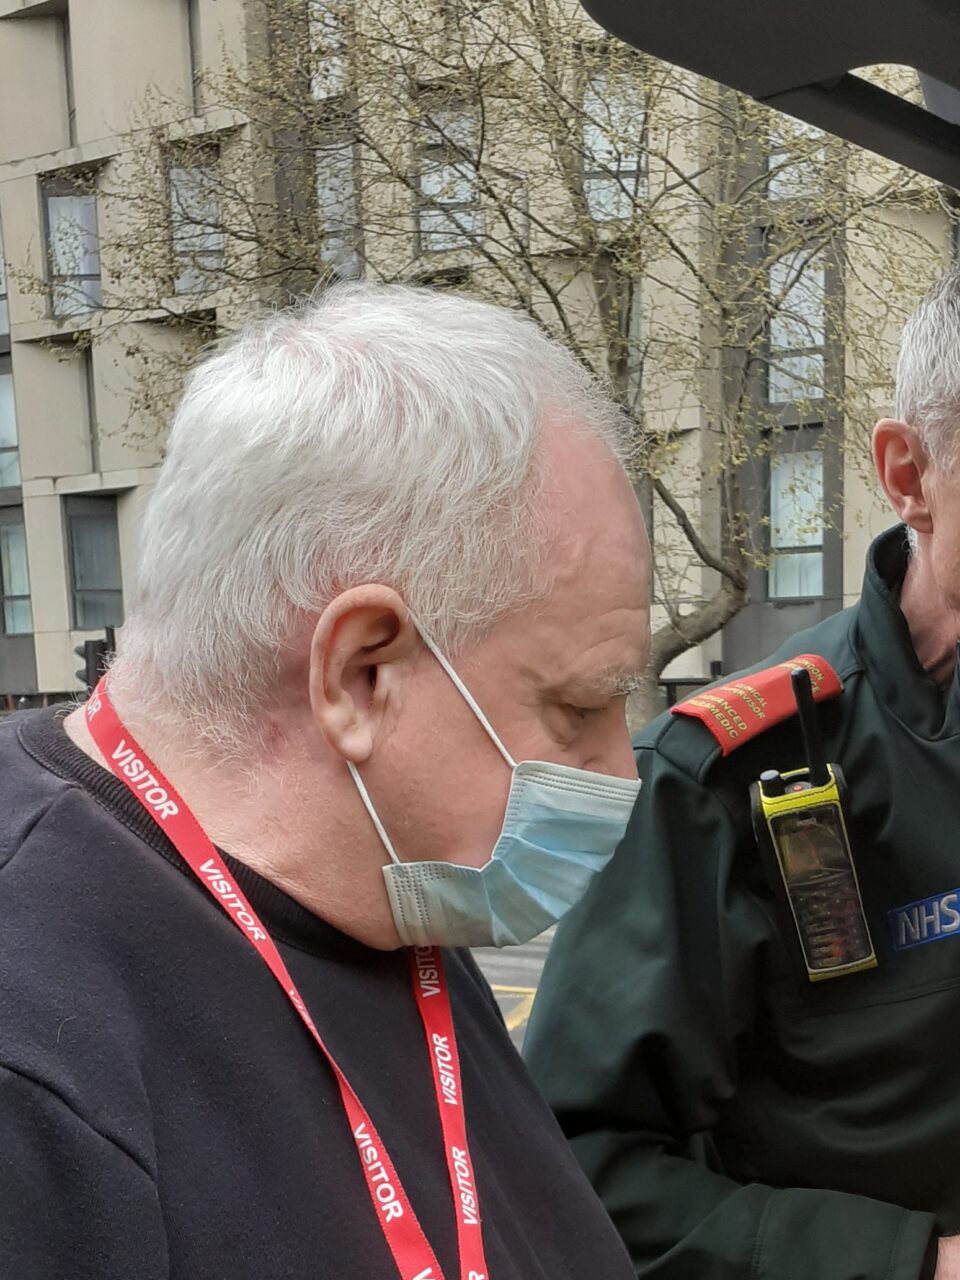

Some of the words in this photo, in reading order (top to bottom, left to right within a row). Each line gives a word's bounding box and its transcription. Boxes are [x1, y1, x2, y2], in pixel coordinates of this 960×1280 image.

[111, 739, 179, 820] VISITOR
[199, 858, 267, 941] VISITOR
[899, 894, 960, 945] NHS
[414, 945, 441, 998] VISITO
[432, 1032, 459, 1105] VISITOR
[353, 1122, 404, 1223] VISITOR
[452, 1146, 479, 1225] VISITOR
